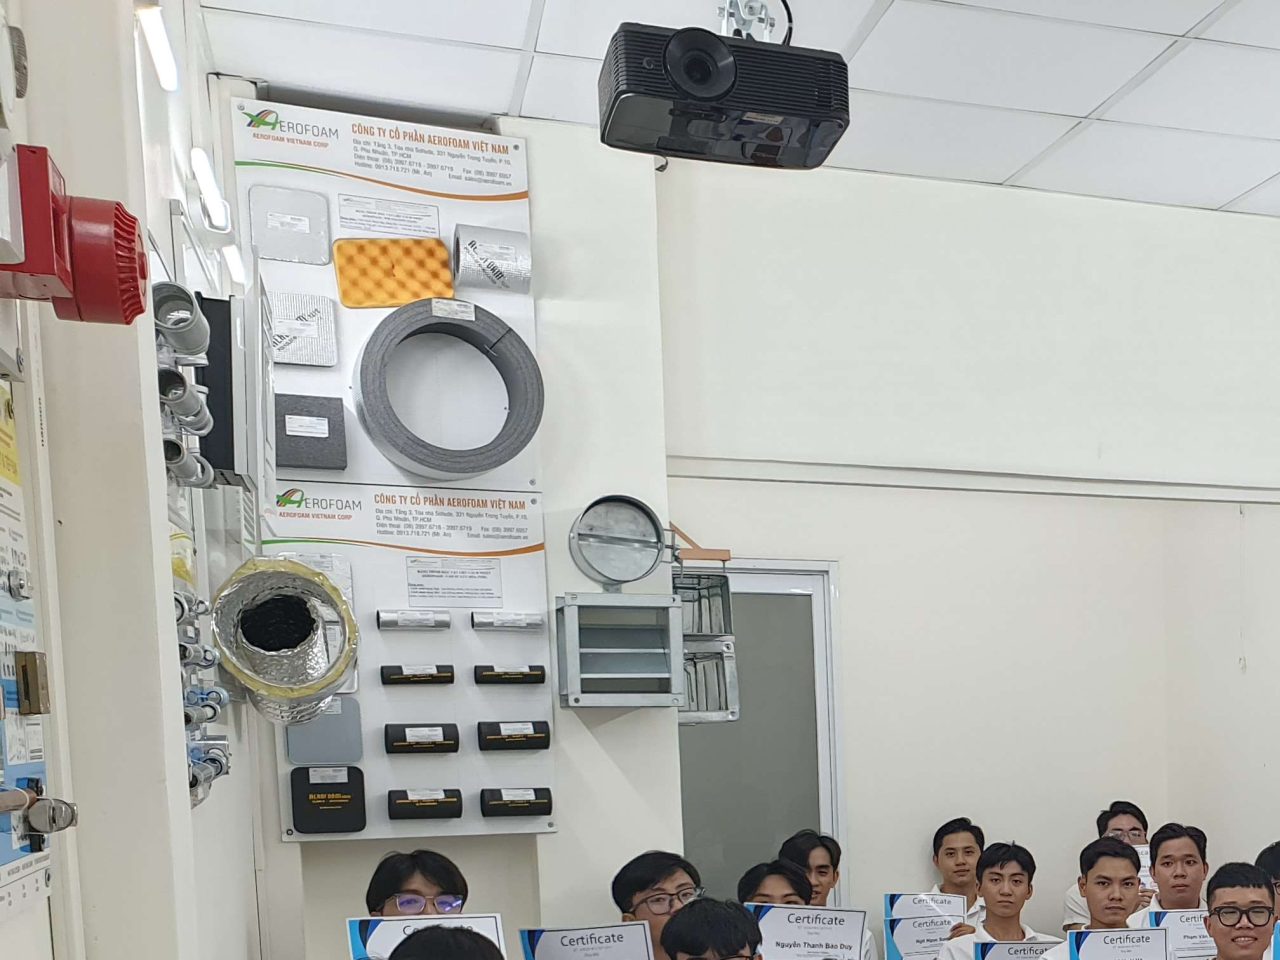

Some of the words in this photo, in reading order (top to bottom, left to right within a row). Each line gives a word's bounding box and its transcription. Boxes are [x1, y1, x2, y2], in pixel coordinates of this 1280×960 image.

[352, 123, 375, 136] CÔNG
[377, 127, 386, 138] TY
[427, 134, 470, 149] AEROFOAM
[472, 141, 489, 153] VIỆT
[491, 144, 509, 154] NAM
[374, 493, 396, 505] CÔNG
[398, 495, 408, 505] TY
[447, 498, 488, 508] AEROFOAM
[490, 499, 506, 510] VIỆT
[509, 501, 526, 510] NAM
[787, 912, 846, 927] Certificate
[560, 931, 625, 948] Certificate
[1103, 934, 1151, 945] Certificate
